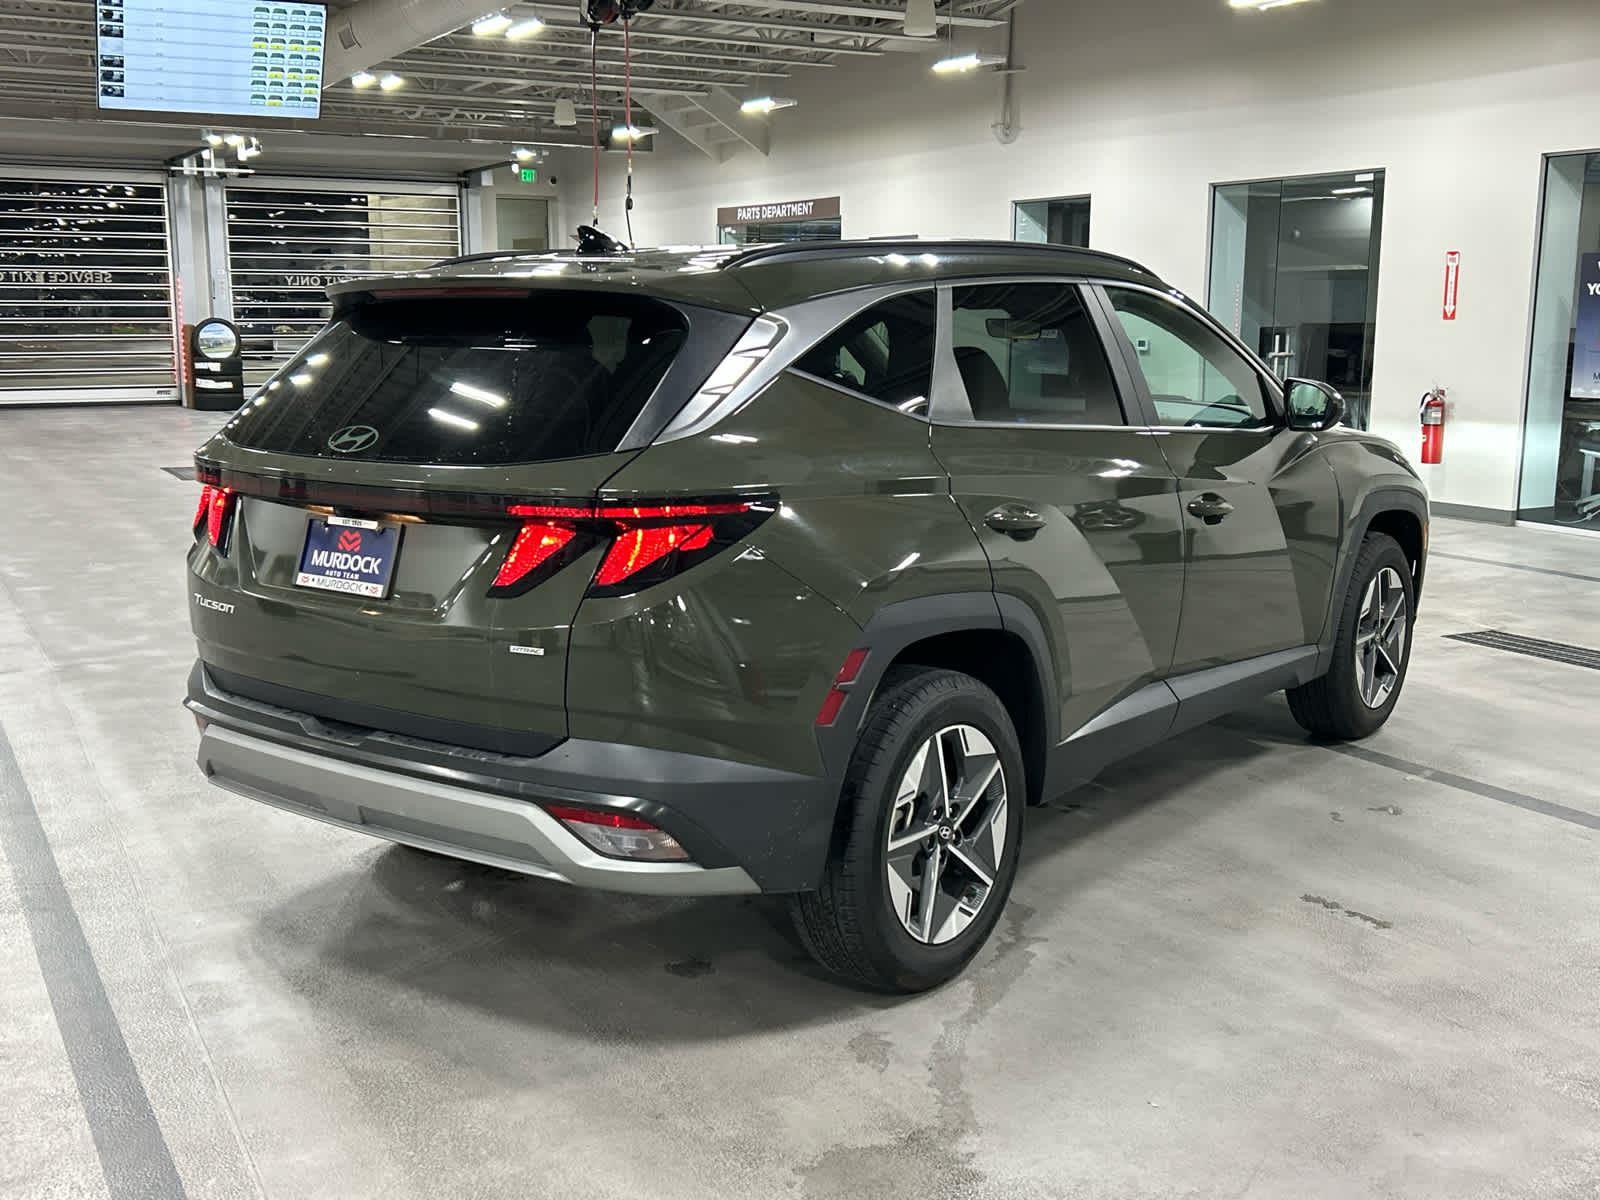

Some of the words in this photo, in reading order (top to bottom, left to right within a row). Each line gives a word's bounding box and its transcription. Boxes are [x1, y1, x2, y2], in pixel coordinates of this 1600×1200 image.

[521, 169, 535, 183] EXIT
[737, 207, 761, 220] PARTS
[761, 202, 814, 219] DEPARTMENT
[311, 549, 383, 575] MURDOCK
[325, 569, 341, 578] AUTO
[342, 571, 360, 580] TEAM
[316, 577, 363, 592] MURDOCK
